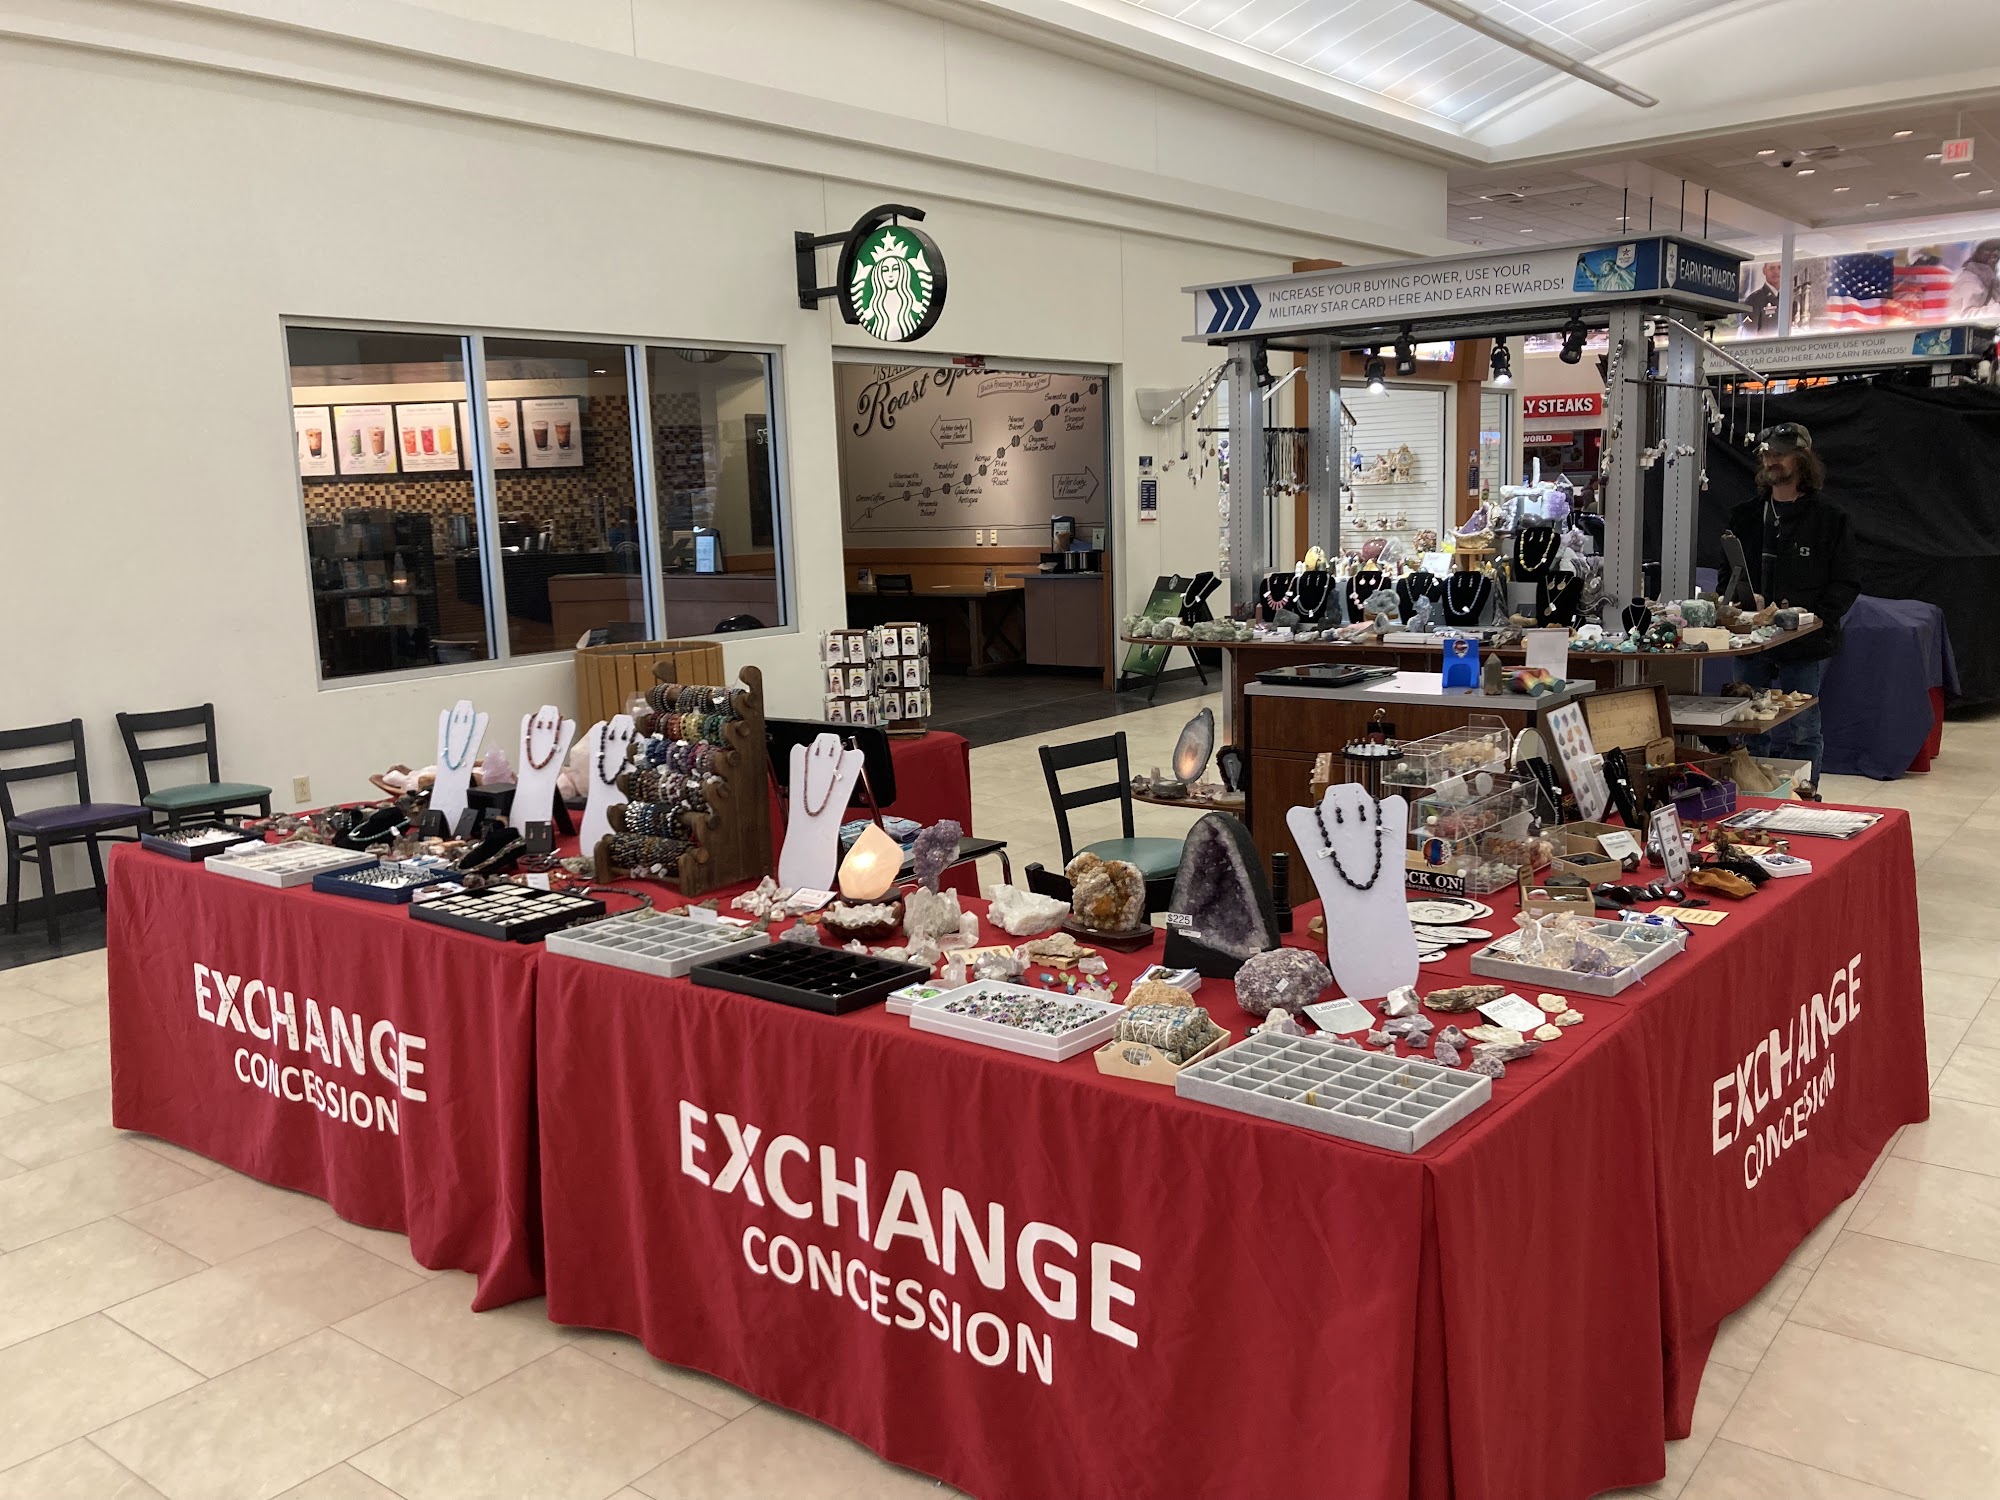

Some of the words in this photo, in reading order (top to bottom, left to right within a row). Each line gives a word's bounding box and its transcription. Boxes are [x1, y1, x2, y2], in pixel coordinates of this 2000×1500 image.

[1269, 286, 1325, 302] INCREASE
[1328, 282, 1360, 296] YOUR
[1364, 276, 1410, 292] BUYING
[1413, 272, 1462, 287] POWER,
[1465, 268, 1490, 281] USE
[1492, 264, 1530, 278] YOUR
[1680, 258, 1700, 281] EARN
[1702, 264, 1736, 292] REWARDS
[1269, 302, 1318, 319] MILITARY
[1320, 300, 1348, 314] STAR
[1351, 297, 1385, 310] CARD
[1389, 292, 1421, 306] HERE
[1424, 290, 1452, 302] AND
[1456, 286, 1491, 300] EARN
[1495, 278, 1565, 294] REWARDS!
[1750, 346, 1774, 356] YOUR
[1776, 343, 1806, 354] BUYING
[1809, 341, 1841, 351] POWER,
[1843, 340, 1858, 348] USE
[1861, 338, 1886, 346] YOUR
[1766, 354, 1790, 363] CARD
[1792, 352, 1813, 362] HERE
[1816, 351, 1834, 360] AND
[1836, 349, 1860, 358] EARN
[1862, 346, 1907, 356] REWARDS!
[853, 372, 930, 436] Roast
[1538, 398, 1593, 413] STEAKS
[1066, 424, 1084, 432] Blend
[992, 478, 1009, 486] Roast
[1435, 876, 1464, 890] ON!
[1167, 914, 1190, 924] $225
[1315, 1001, 1351, 1011] Lepidolite
[194, 962, 427, 1103] EXCHANGE
[1712, 952, 1862, 1156] EXCHANGE
[234, 1048, 400, 1136] CONCESSION
[678, 1099, 1142, 1349] EXCHANGE
[742, 1225, 1053, 1386] CONCESSION
